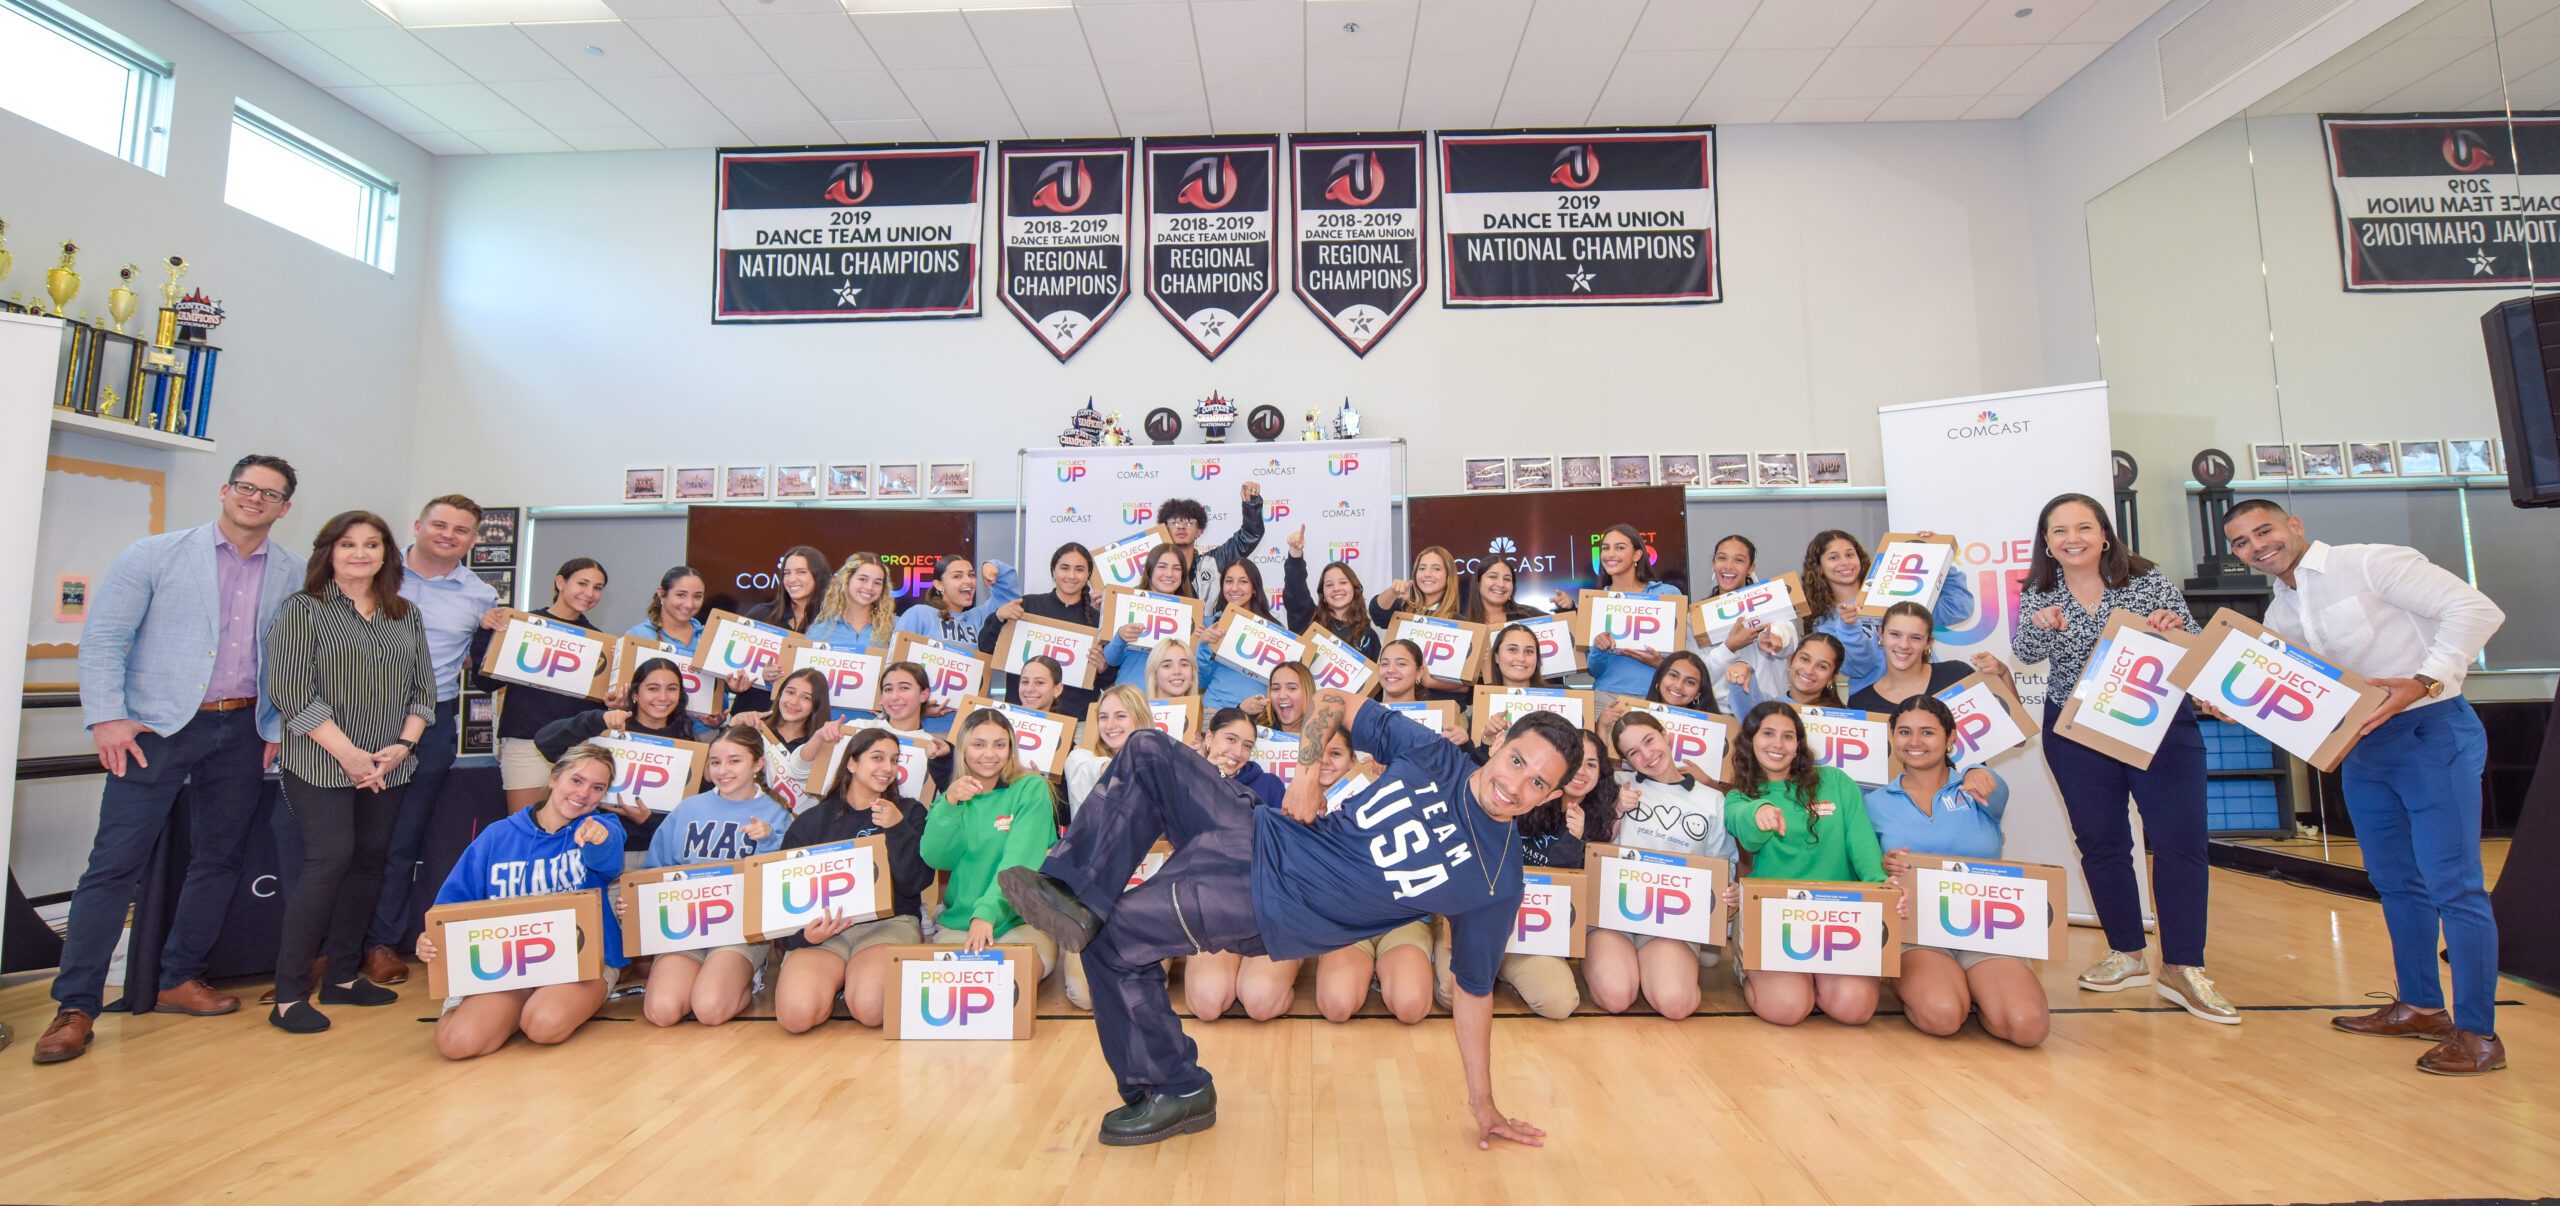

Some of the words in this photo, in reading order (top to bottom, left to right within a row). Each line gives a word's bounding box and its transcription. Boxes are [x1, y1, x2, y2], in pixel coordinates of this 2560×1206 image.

[1558, 195, 1601, 211] 2019
[830, 211, 872, 226] 2019
[1023, 219, 1108, 235] 2018-2019
[1169, 217, 1254, 232] 2018-2019
[1317, 213, 1402, 228] 2018-2019
[1483, 212, 1553, 230] DANCE
[1557, 211, 1614, 229] TEAM
[1619, 210, 1685, 227] UNION
[756, 229, 822, 246] DANCE
[828, 228, 881, 244] TEAM
[886, 225, 952, 243] UNION
[1011, 235, 1049, 246] DANCE
[1052, 234, 1081, 245] TEAM
[1083, 233, 1120, 244] UNION
[1157, 233, 1195, 243] DANCE
[1198, 232, 1228, 242] TEAM
[1230, 230, 1266, 241] UNION
[1305, 229, 1343, 240] DANCE
[1346, 229, 1376, 239] TEAM
[1378, 228, 1415, 238] UNION
[1170, 247, 1254, 269] REGIONAL
[1318, 244, 1403, 265] REGIONAL
[1467, 237, 1567, 262] NATIONAL
[1572, 234, 1696, 260] CHAMPIONS
[738, 252, 835, 279] NATIONAL
[841, 249, 960, 276] CHAMPIONS
[1023, 250, 1107, 271] REGIONAL
[1013, 275, 1117, 296] CHAMPIONS
[1160, 271, 1264, 294] CHAMPIONS
[1308, 268, 1412, 291] CHAMPIONS
[1947, 420, 2031, 440] COMCAST
[1057, 466, 1086, 482] UP
[1117, 471, 1160, 479] COMCAST
[1191, 464, 1221, 481] UP
[1253, 467, 1296, 476] COMCAST
[1328, 459, 1359, 476] UP
[1050, 515, 1091, 523] COMCAST
[1123, 509, 1153, 525] UP
[1206, 512, 1227, 521] CAST
[1322, 509, 1366, 517] COMCAST
[1107, 542, 1150, 564] PROJECT
[1253, 556, 1287, 564] COMCA
[1329, 549, 1360, 564] UP
[1877, 553, 1902, 595] PROJECT
[1888, 554, 1929, 596] UP
[1129, 602, 1178, 617] PROJECT
[1605, 605, 1661, 616] PROJECT
[1717, 593, 1773, 620] UP
[1128, 611, 1178, 640] UP
[1605, 614, 1660, 641] UP
[523, 631, 585, 654] PROJECT
[731, 630, 780, 650] PROJEC
[1027, 630, 1078, 648] PROJECT
[1244, 625, 1291, 651] PROJECT
[1410, 629, 1458, 643] PROJECT
[724, 640, 780, 673] UP
[1235, 632, 1285, 665] UP
[516, 642, 581, 677] UP
[810, 656, 866, 670] PROJECT
[921, 653, 970, 672] PROJECT
[1317, 644, 1359, 675] PROJECT
[2093, 646, 2136, 714] PROJECT
[2241, 647, 2330, 699] PROJECT
[2109, 655, 2169, 727] UP
[2221, 660, 2314, 722] UP
[1506, 702, 1566, 713] PROJECT
[1009, 718, 1046, 733] OJECT
[1659, 718, 1710, 737] ROJECT
[1016, 731, 1042, 751] P
[606, 747, 674, 765] PROJECT
[1250, 750, 1298, 760] PROJEC
[766, 751, 806, 797] PROJECT
[1415, 781, 1472, 867] TEAM
[1355, 779, 1449, 901] USA
[1637, 827, 1654, 836] peace
[1655, 831, 1666, 840] love
[1667, 836, 1690, 848] dance
[782, 857, 854, 880] PROJECT
[1619, 869, 1692, 889] PROJECT
[658, 884, 733, 903] PROJECT
[782, 872, 856, 915] UP
[1938, 881, 2024, 901] PROJECT
[1618, 883, 1691, 924] UP
[659, 899, 734, 940] UP
[1781, 909, 1862, 923] PROJECT
[1939, 895, 2025, 940] UP
[468, 922, 554, 942] PROJECT
[1782, 922, 1862, 961] UP
[469, 937, 556, 981] UP
[920, 971, 995, 984] PROJECT
[920, 986, 995, 1027] UP
